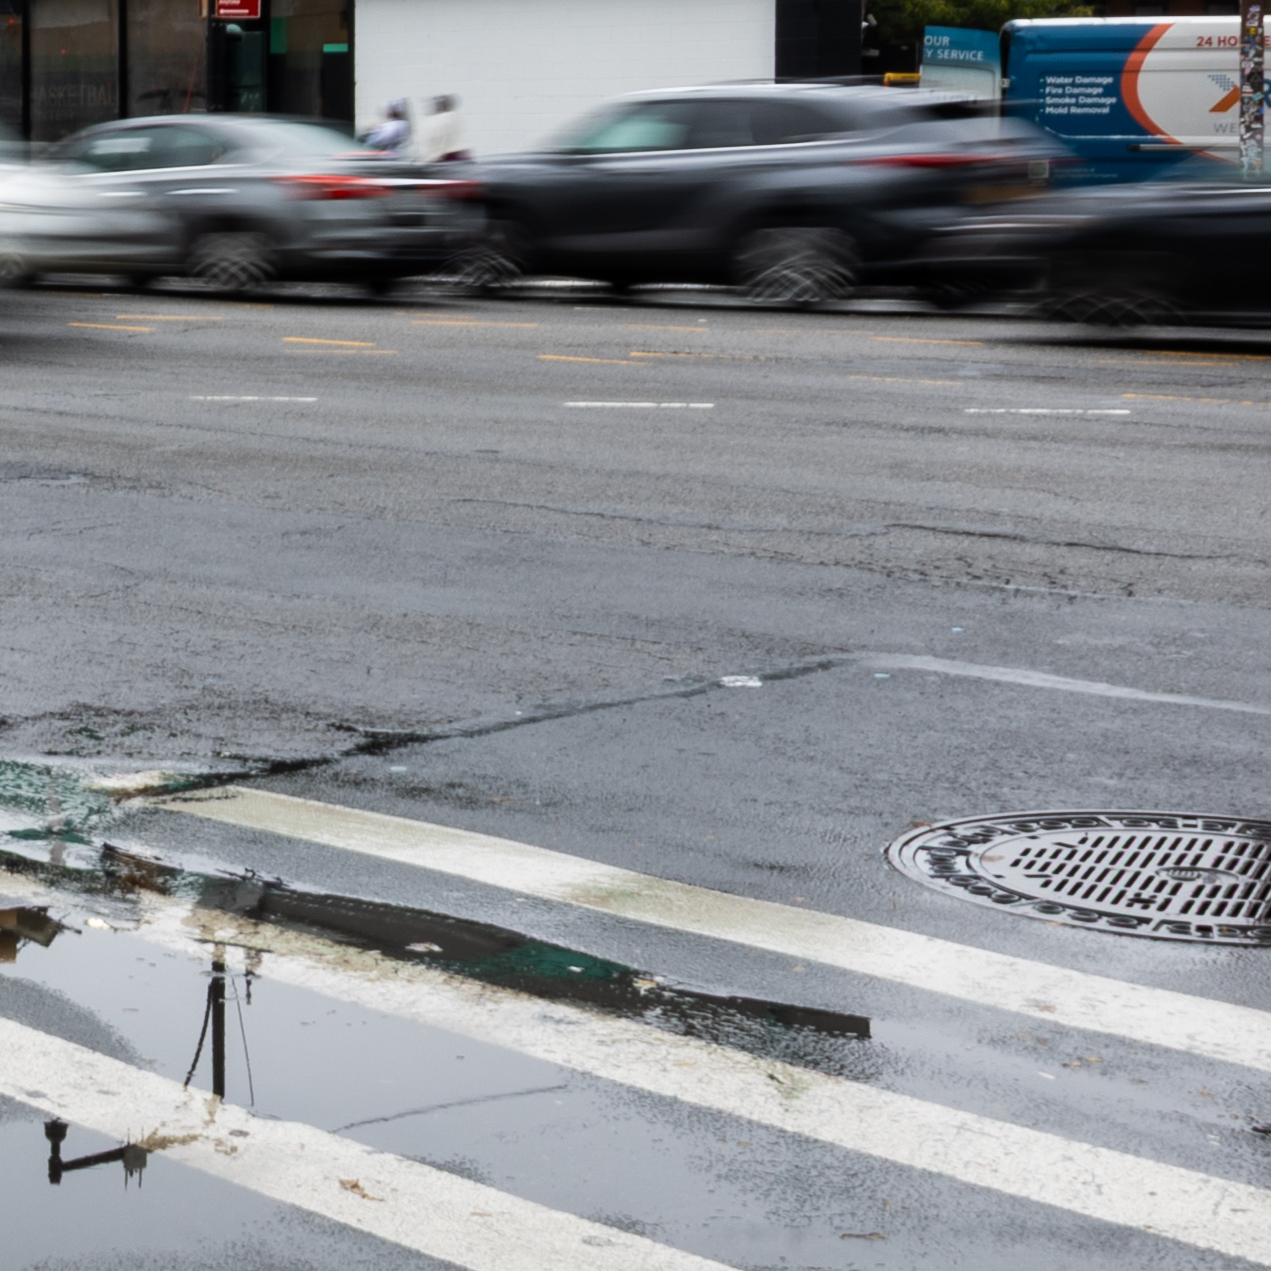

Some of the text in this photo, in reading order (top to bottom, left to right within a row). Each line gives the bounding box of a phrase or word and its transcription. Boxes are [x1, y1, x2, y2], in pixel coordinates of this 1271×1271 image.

[1196, 36, 1213, 47] 24
[937, 49, 984, 61] SERVICE
[1045, 76, 1114, 85] Water Damage
[1045, 86, 1104, 95] Fire Damage
[1045, 96, 1117, 105] Smoke Damage
[1045, 106, 1110, 114] Mold Removal
